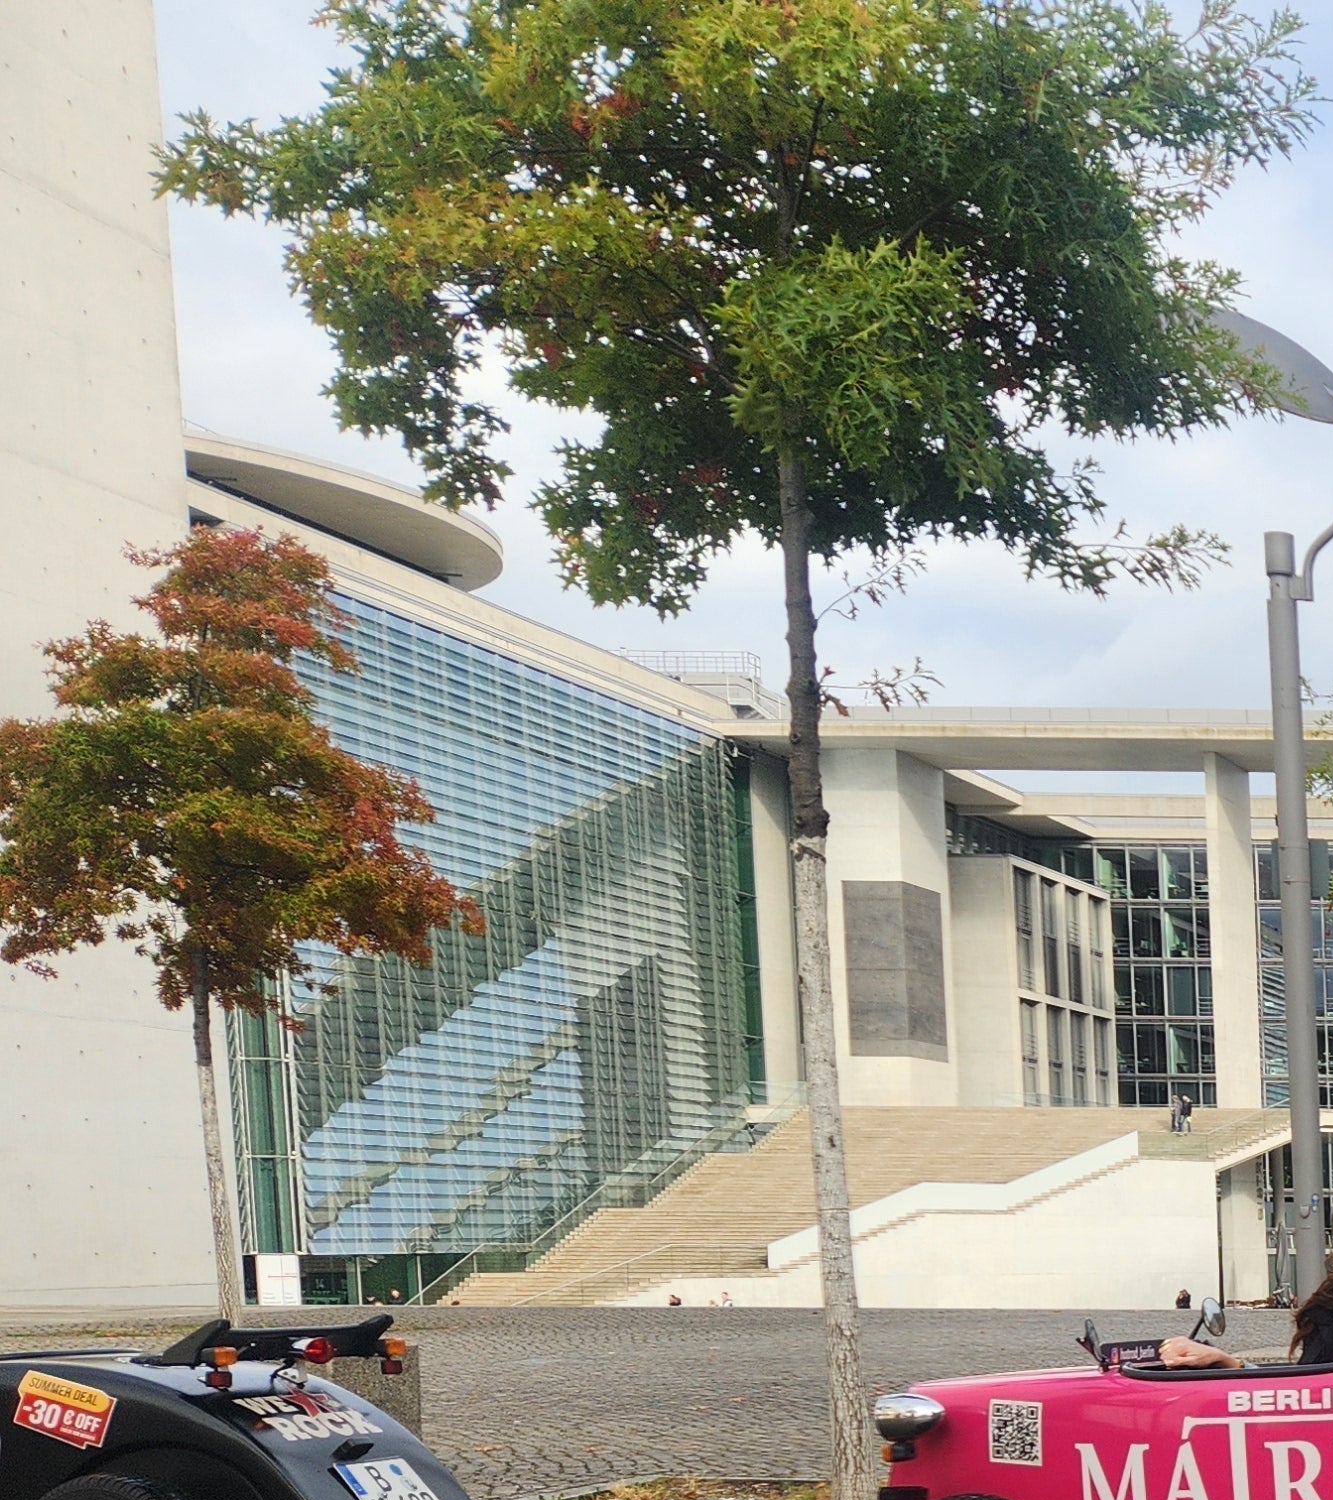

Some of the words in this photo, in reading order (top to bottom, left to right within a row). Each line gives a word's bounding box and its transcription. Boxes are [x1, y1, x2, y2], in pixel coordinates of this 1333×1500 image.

[29, 1377, 73, 1399] SUMMER
[73, 1389, 99, 1407] DEAL
[232, 1395, 300, 1416] WE
[22, 1399, 62, 1429] -30
[75, 1413, 102, 1433] OFF
[262, 1408, 384, 1441] ROCK
[364, 1466, 392, 1492] B
